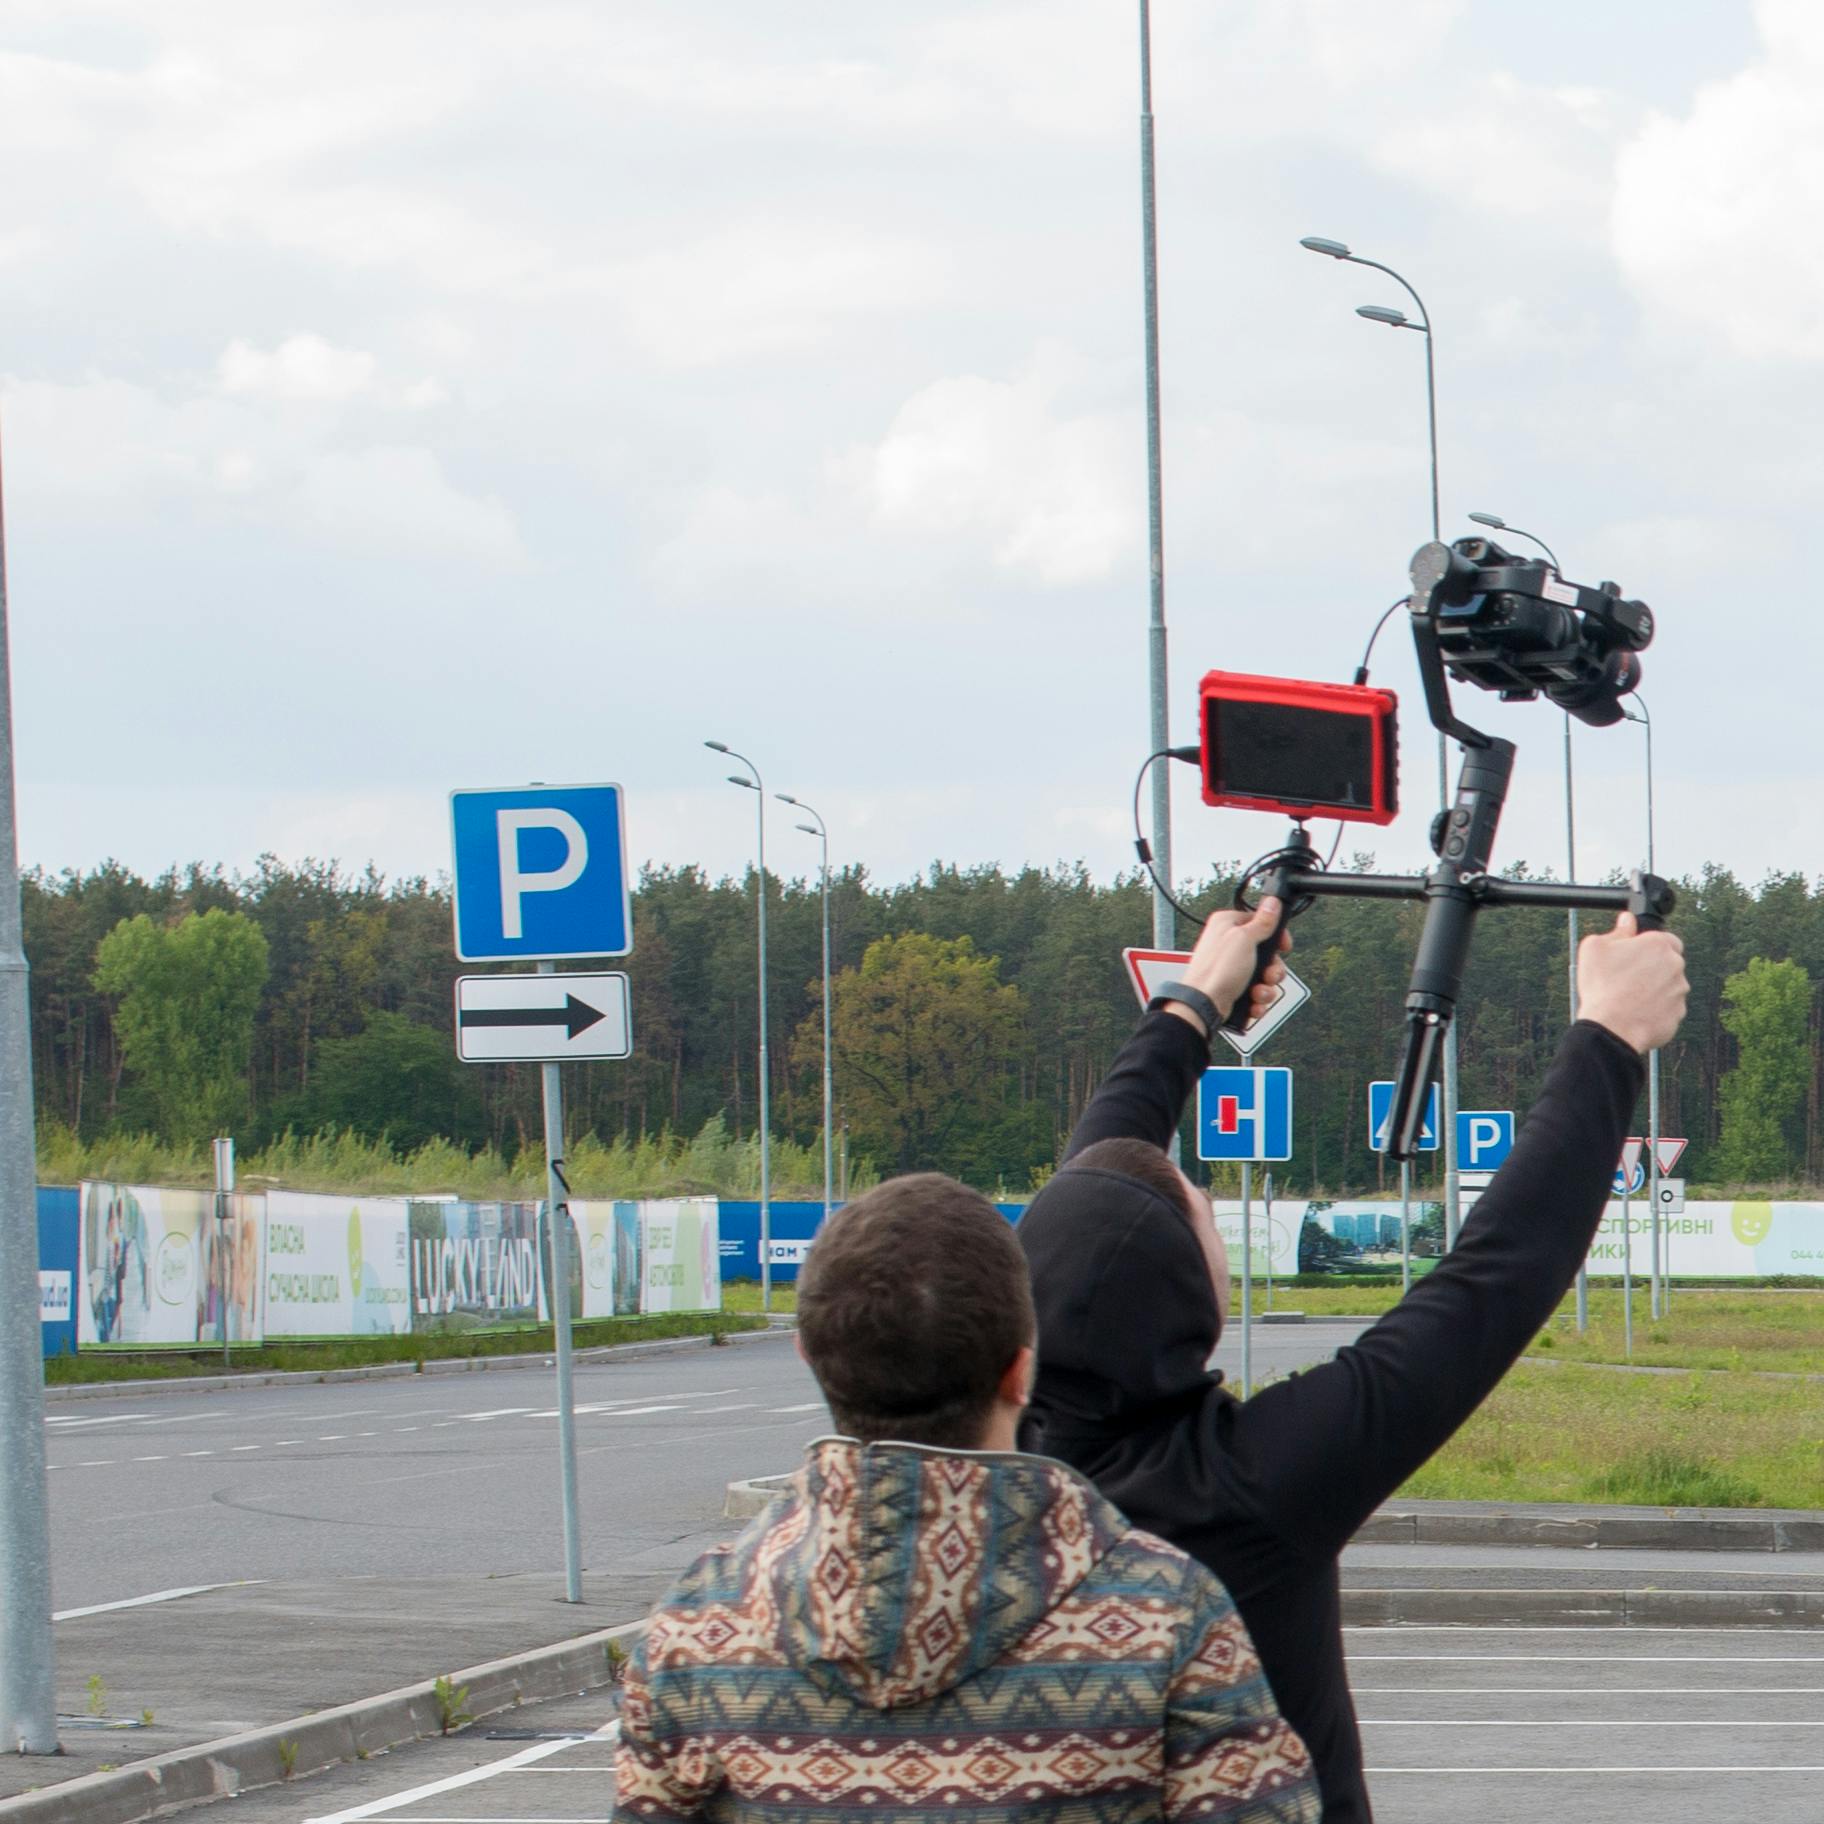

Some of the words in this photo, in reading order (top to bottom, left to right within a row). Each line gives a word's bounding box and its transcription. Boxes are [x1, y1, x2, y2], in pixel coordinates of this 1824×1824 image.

[497, 807, 589, 939] P
[1469, 1118, 1501, 1164] P
[414, 1238, 480, 1314] LUCKY
[483, 1238, 535, 1310] LAND
[1791, 1249, 1813, 1260] 044
